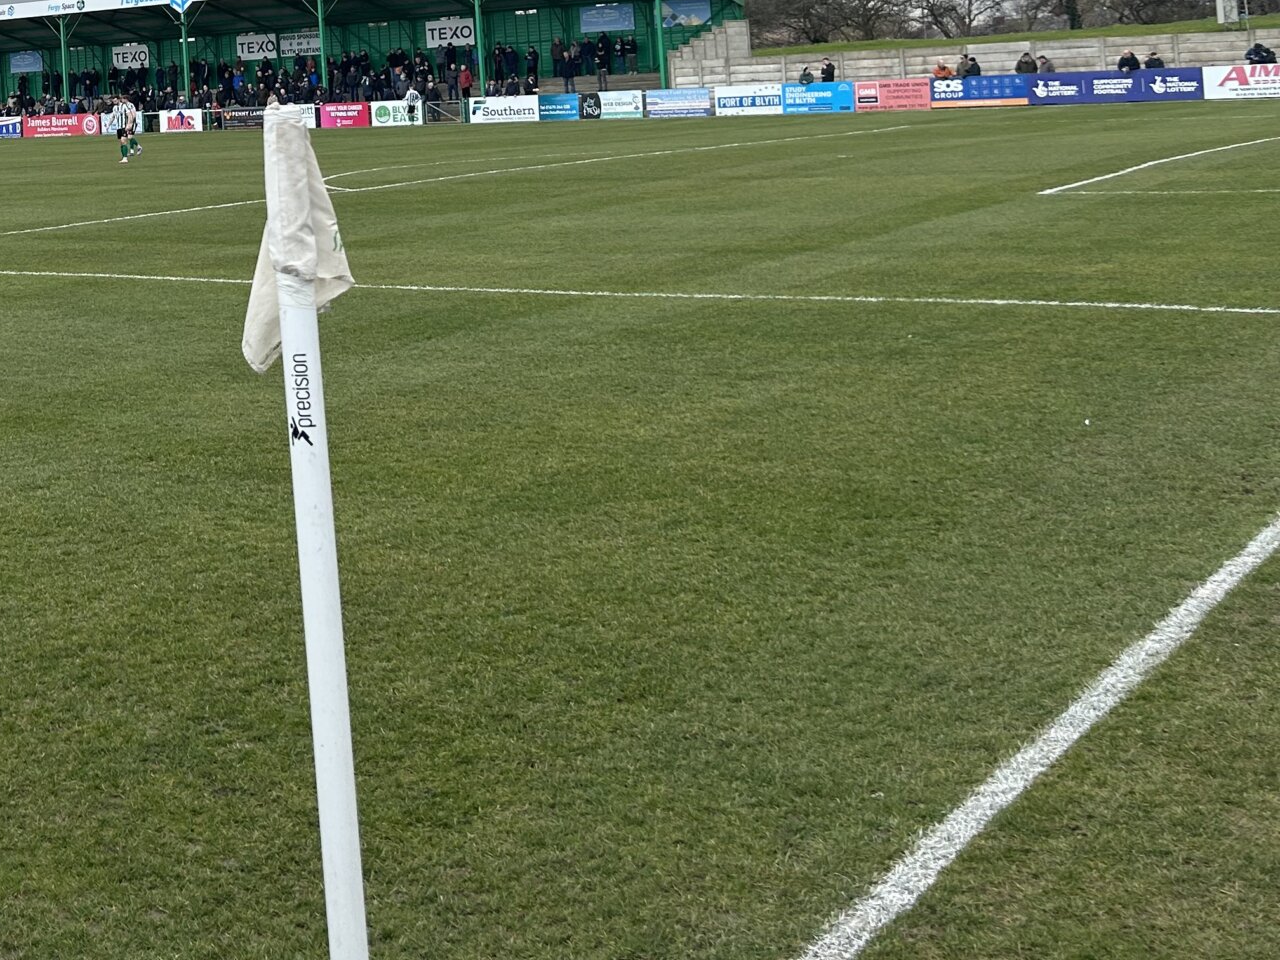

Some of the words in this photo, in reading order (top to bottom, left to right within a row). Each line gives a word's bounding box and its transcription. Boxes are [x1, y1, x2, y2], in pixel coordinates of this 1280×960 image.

[47, 4, 61, 12] Fergy
[61, 2, 75, 10] Space
[428, 25, 473, 40] TEXO
[238, 40, 276, 54] TEXO
[114, 50, 147, 63] TEXO
[933, 79, 964, 92] SOS
[720, 97, 741, 107] PORT
[742, 96, 753, 106] OF
[755, 95, 780, 106] BLYTH
[392, 104, 419, 113] BLYH
[482, 105, 535, 117] Southern
[27, 116, 51, 127] James
[51, 115, 79, 126] Burrell
[291, 353, 317, 427] precision
